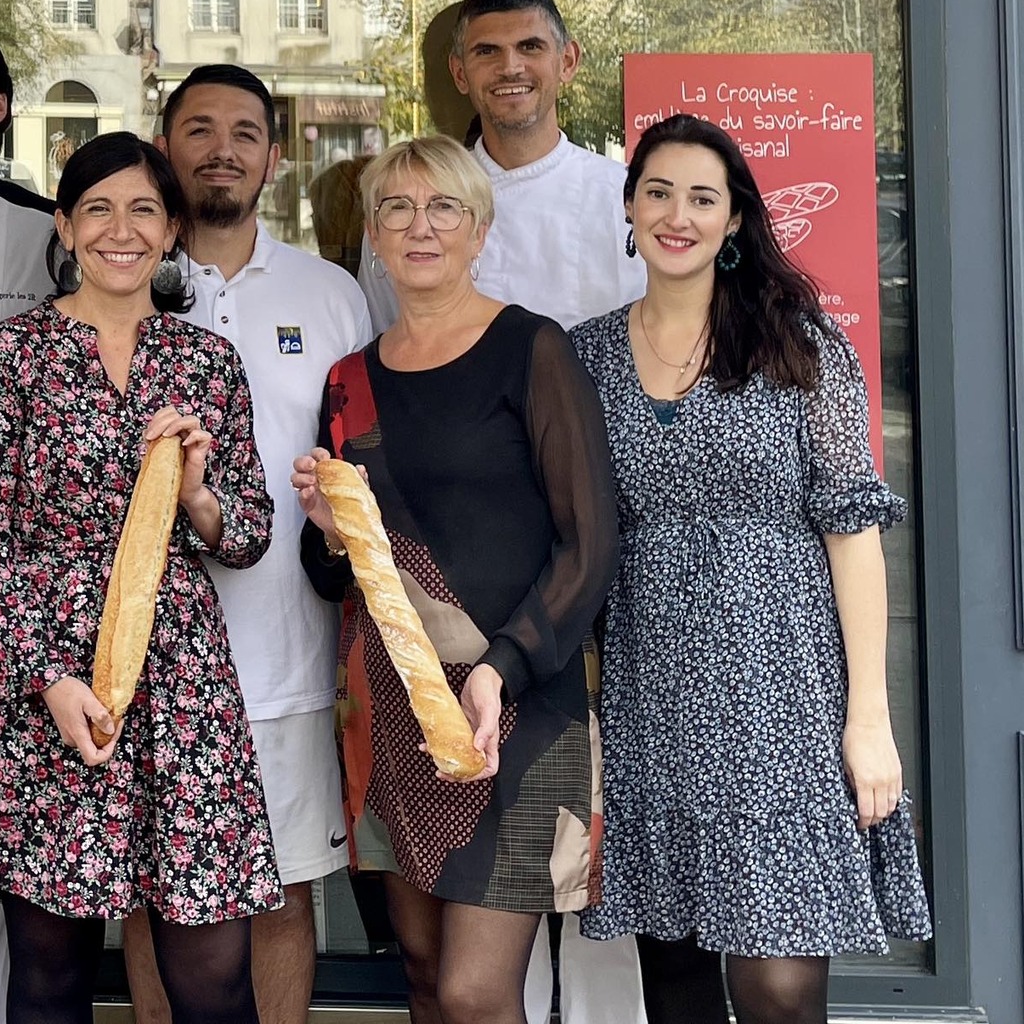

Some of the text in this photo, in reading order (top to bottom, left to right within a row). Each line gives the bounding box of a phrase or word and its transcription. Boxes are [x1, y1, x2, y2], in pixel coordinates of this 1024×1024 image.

[681, 81, 707, 103] La
[716, 83, 798, 110] Croquise
[719, 107, 744, 130] du
[752, 102, 863, 131] savoir-faire
[738, 133, 790, 158] isanal
